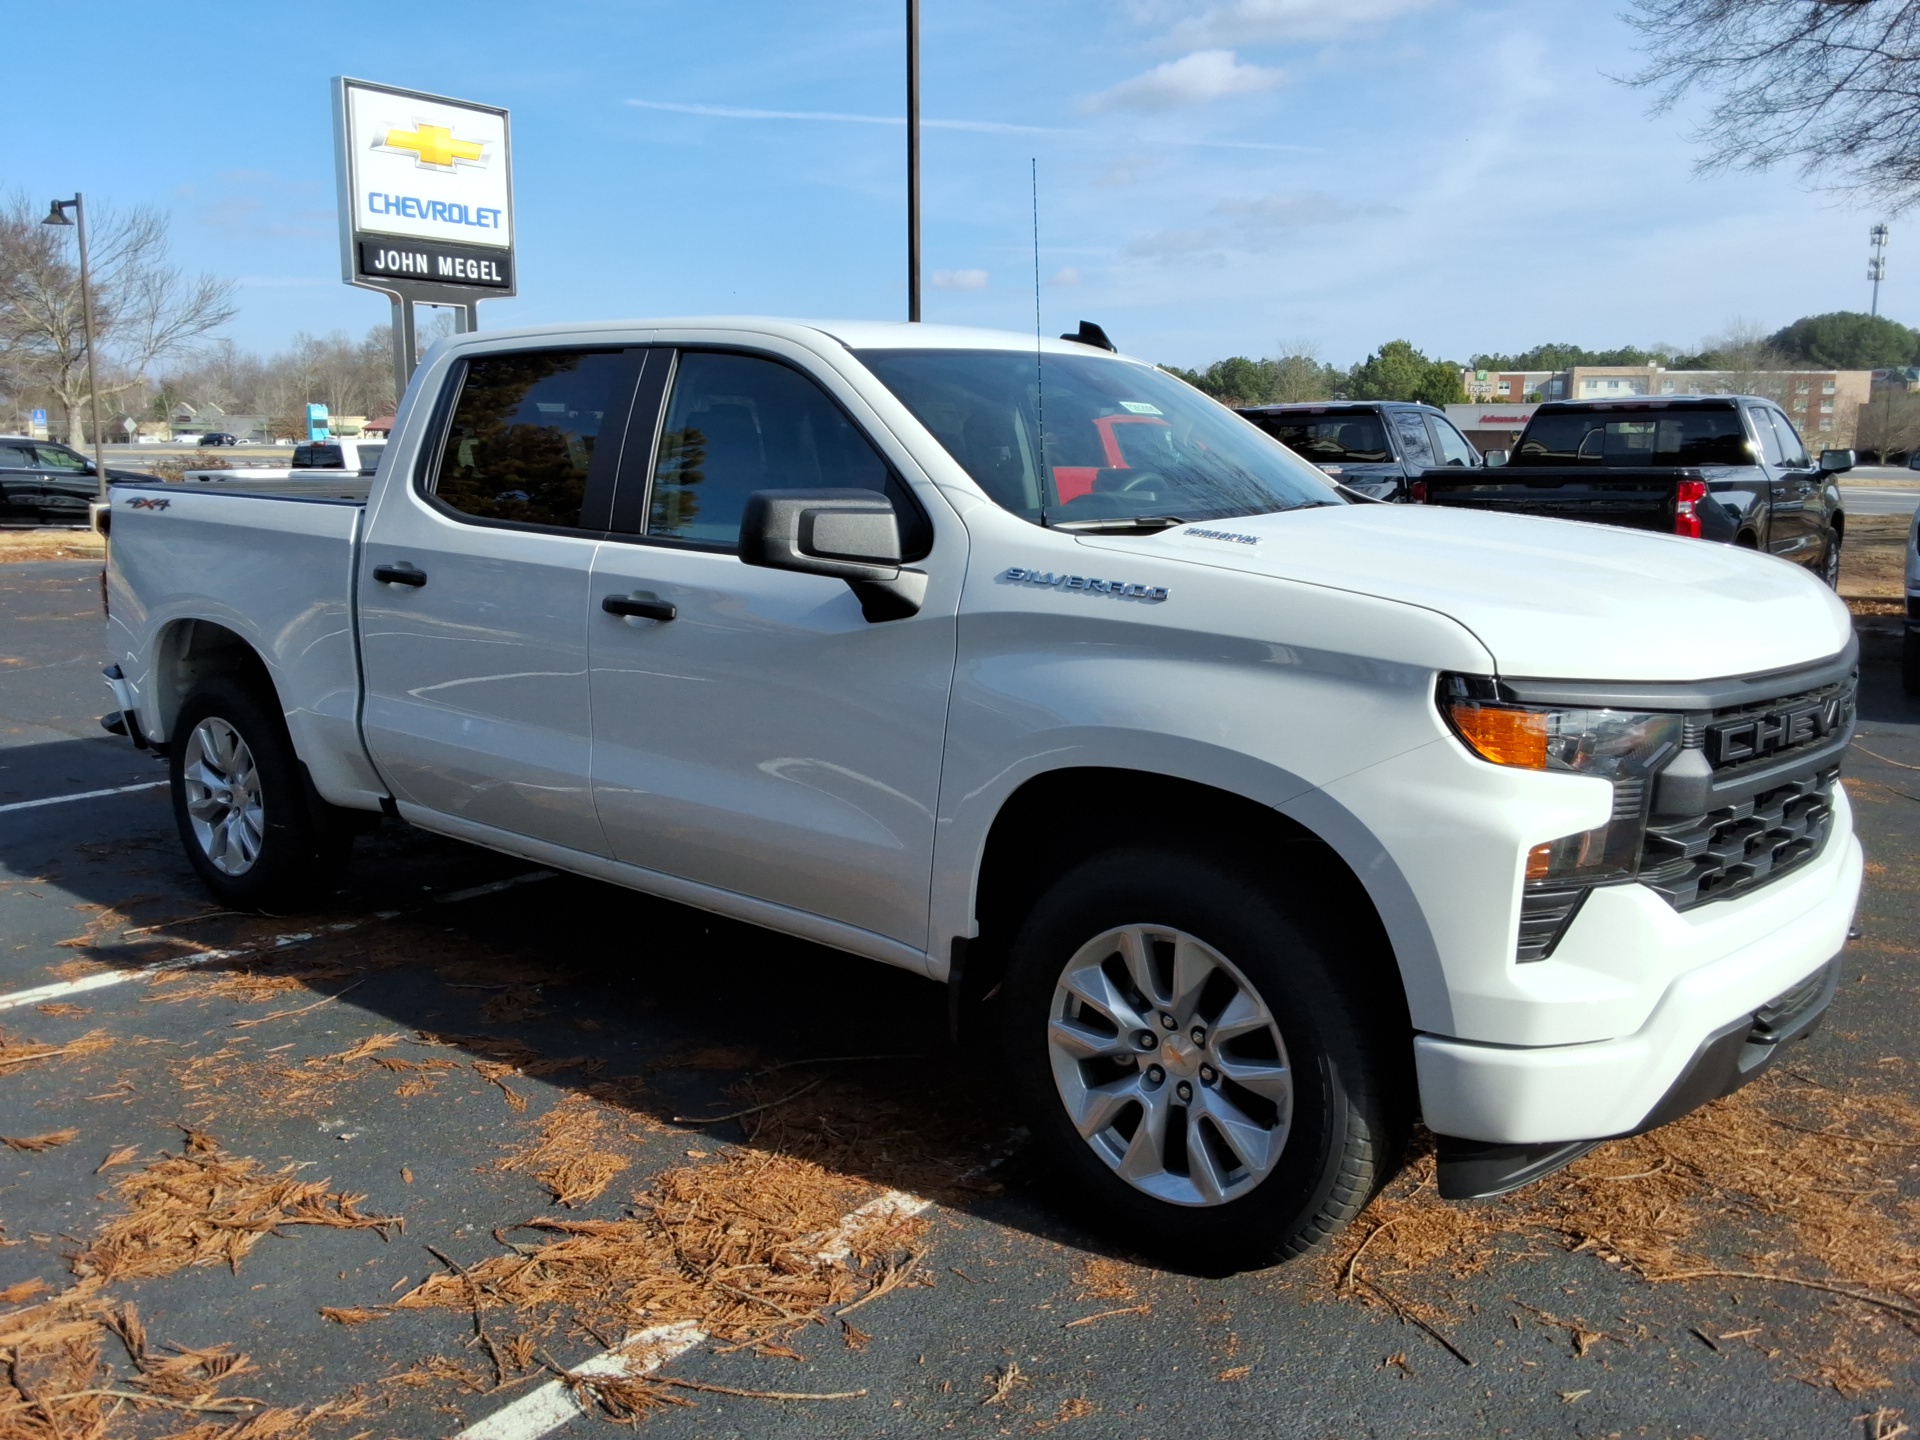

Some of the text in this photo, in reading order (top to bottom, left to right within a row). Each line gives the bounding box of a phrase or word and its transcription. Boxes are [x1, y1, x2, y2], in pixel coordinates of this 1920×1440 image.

[368, 191, 502, 229] CHEVROLET
[375, 249, 502, 281] JOHN MEGEL
[1005, 566, 1171, 600] SILVERADO
